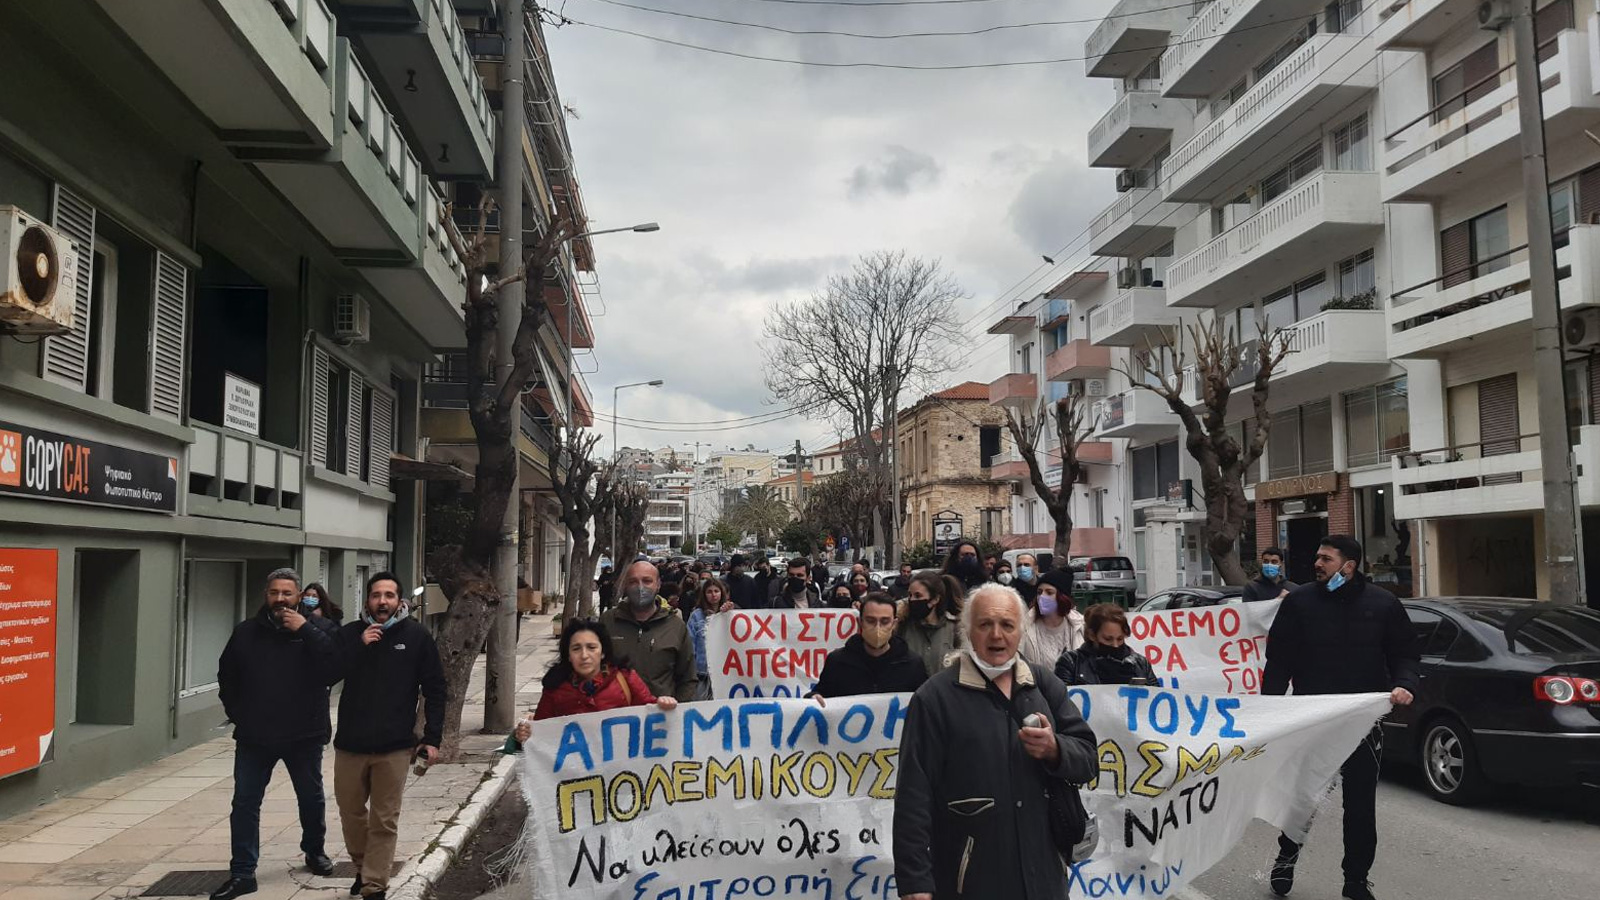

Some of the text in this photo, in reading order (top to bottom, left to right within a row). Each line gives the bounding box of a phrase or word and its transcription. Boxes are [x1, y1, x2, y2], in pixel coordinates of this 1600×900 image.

[104, 464, 132, 482] Ψηφιακό
[104, 482, 163, 503] Φωτοτυπικό Κέντρο
[730, 612, 787, 643] ΟΧΙ
[797, 612, 862, 643] ΣΤΟ
[1118, 686, 1246, 738] ΤΟΥΣ
[557, 747, 901, 834] ΠΟΛΕΜΙΚΟΥΣ
[1124, 775, 1220, 848] ΝΑΤΟ
[569, 834, 633, 888] Να
[776, 817, 841, 860] όλες
